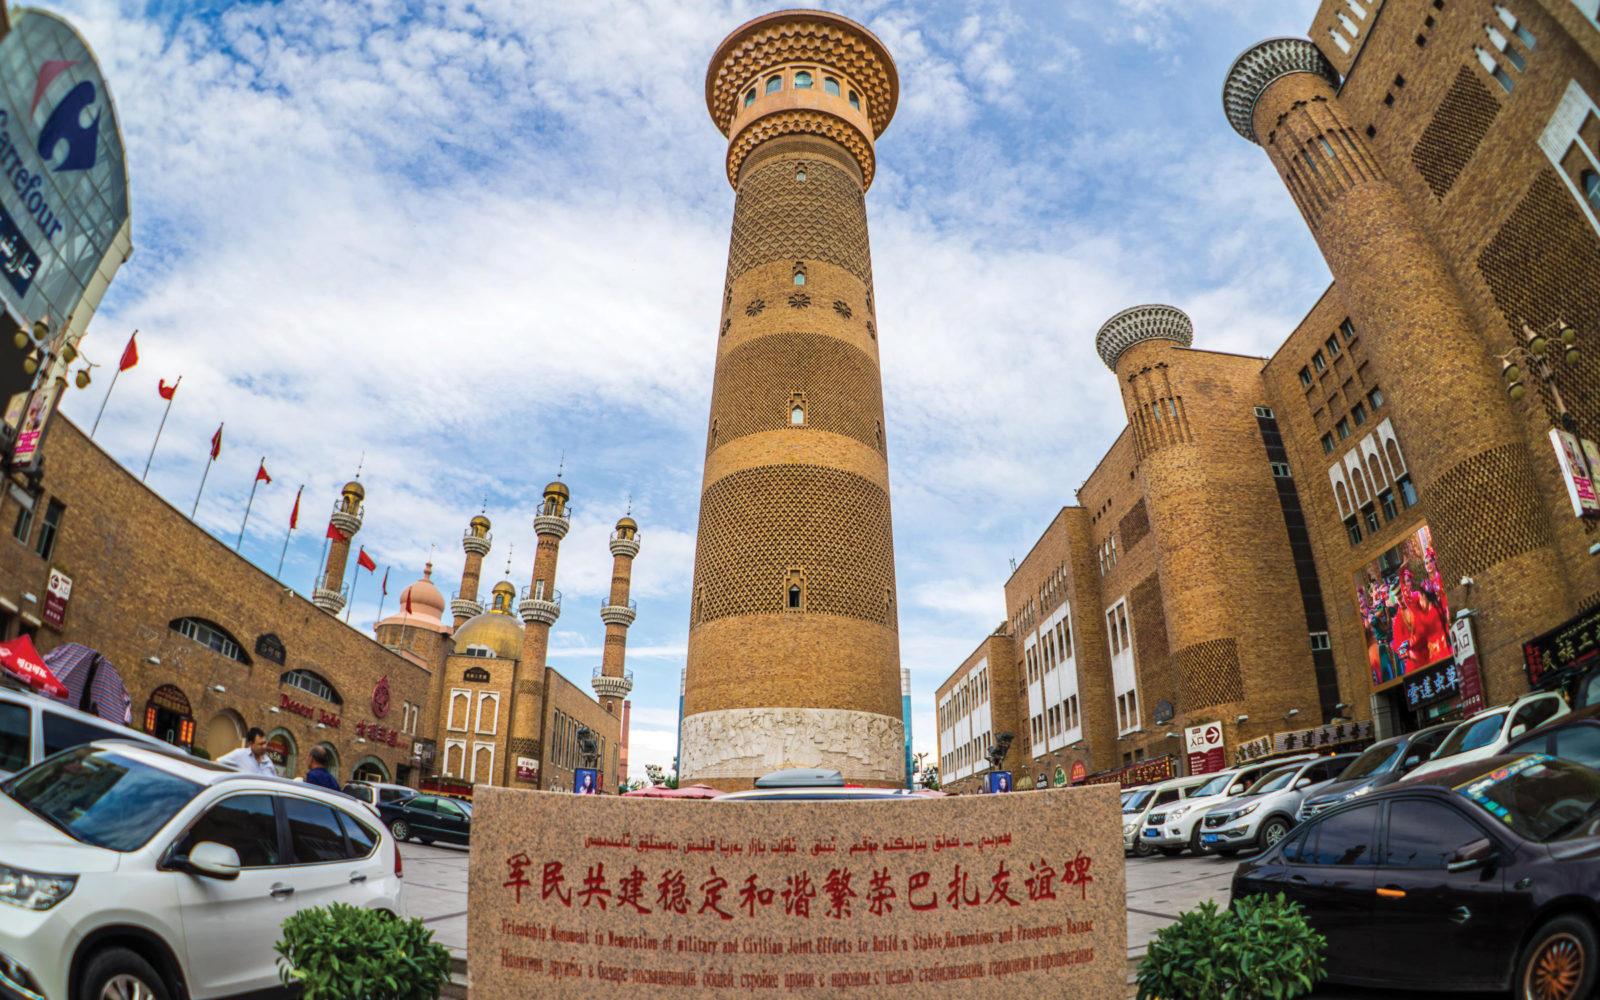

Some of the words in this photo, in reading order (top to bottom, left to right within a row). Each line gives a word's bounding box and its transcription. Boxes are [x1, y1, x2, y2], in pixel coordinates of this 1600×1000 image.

[1191, 736, 1204, 747] 入口
[502, 850, 1094, 920] 军民共建稳定和谐繁荣巴扎友谊碑
[502, 918, 546, 942] Friendship
[551, 923, 588, 945] Monument
[595, 928, 603, 946] in
[662, 934, 672, 951] of
[722, 937, 738, 954] and
[743, 937, 783, 955] Civilian
[787, 937, 812, 954] Joint
[817, 936, 853, 954] Efforts
[858, 937, 868, 953] to
[873, 934, 898, 952] Build
[902, 939, 909, 951] a
[999, 925, 1013, 944] and
[1017, 920, 1062, 941] Prosperous
[1067, 917, 1094, 935] Bazaar
